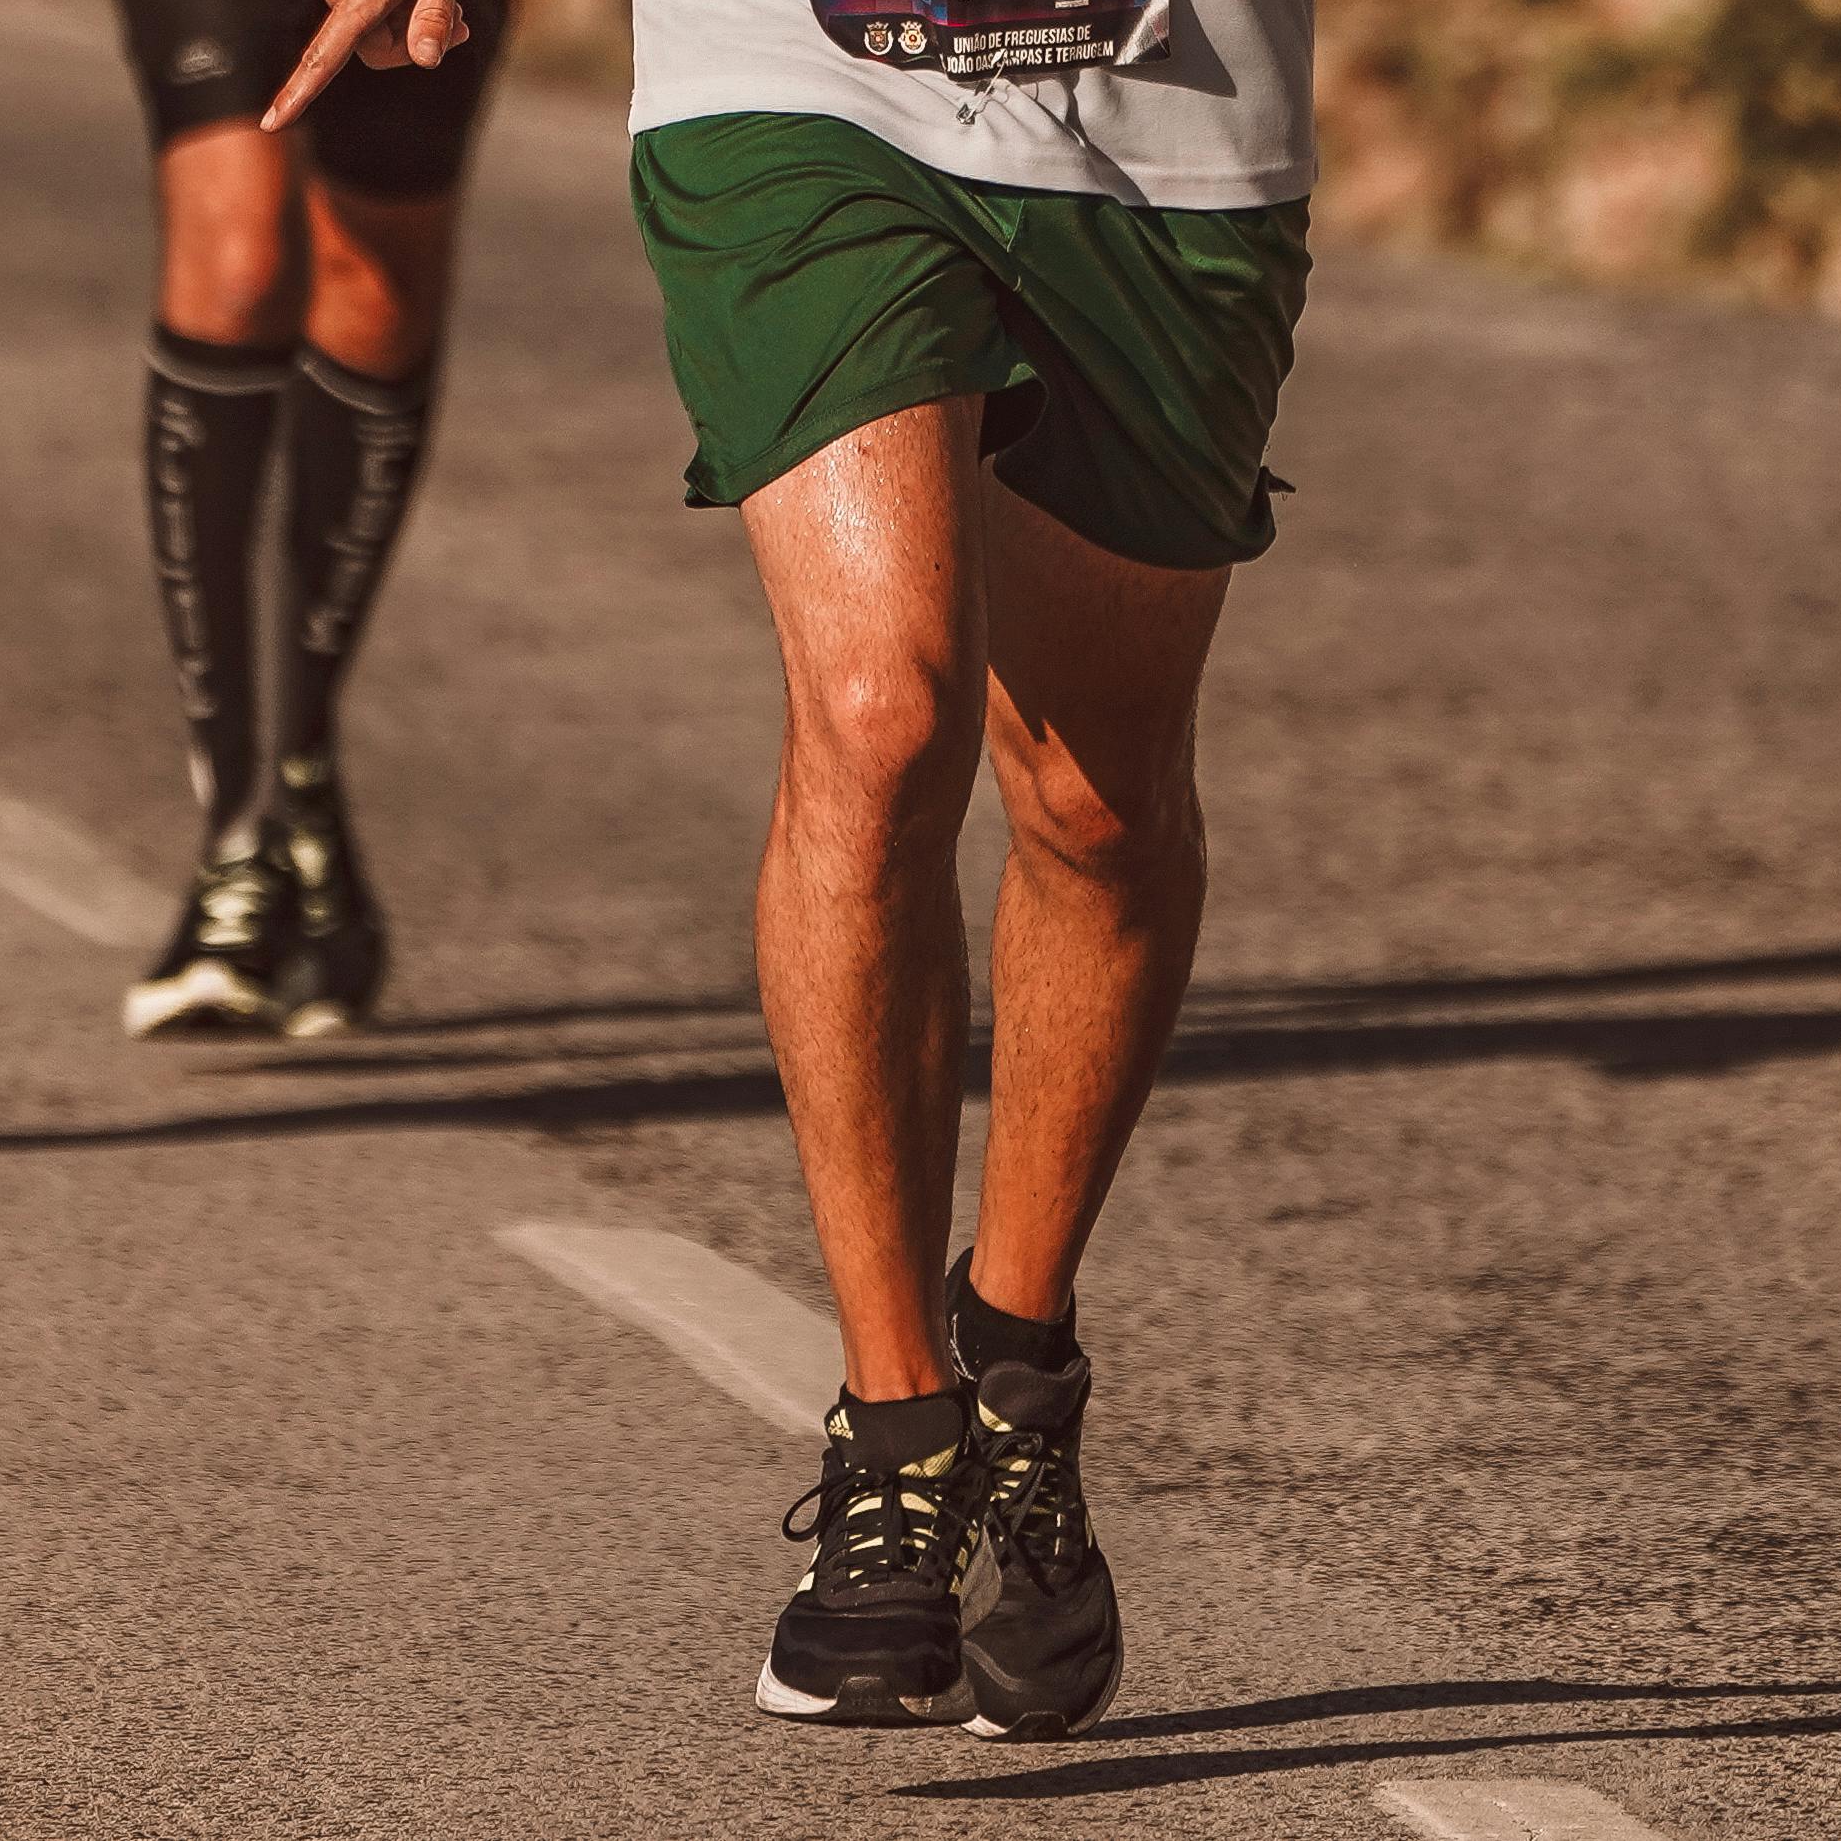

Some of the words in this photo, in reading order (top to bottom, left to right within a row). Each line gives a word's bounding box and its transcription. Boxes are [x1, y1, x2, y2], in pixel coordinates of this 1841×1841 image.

[953, 33, 987, 54] UNIÃO
[988, 31, 1002, 48] DE
[1004, 26, 1075, 47] FREGUESIAS
[1077, 24, 1093, 41] DE
[975, 53, 994, 72] DAS
[1045, 48, 1053, 64] E
[1056, 40, 1114, 63] TERRUGEM
